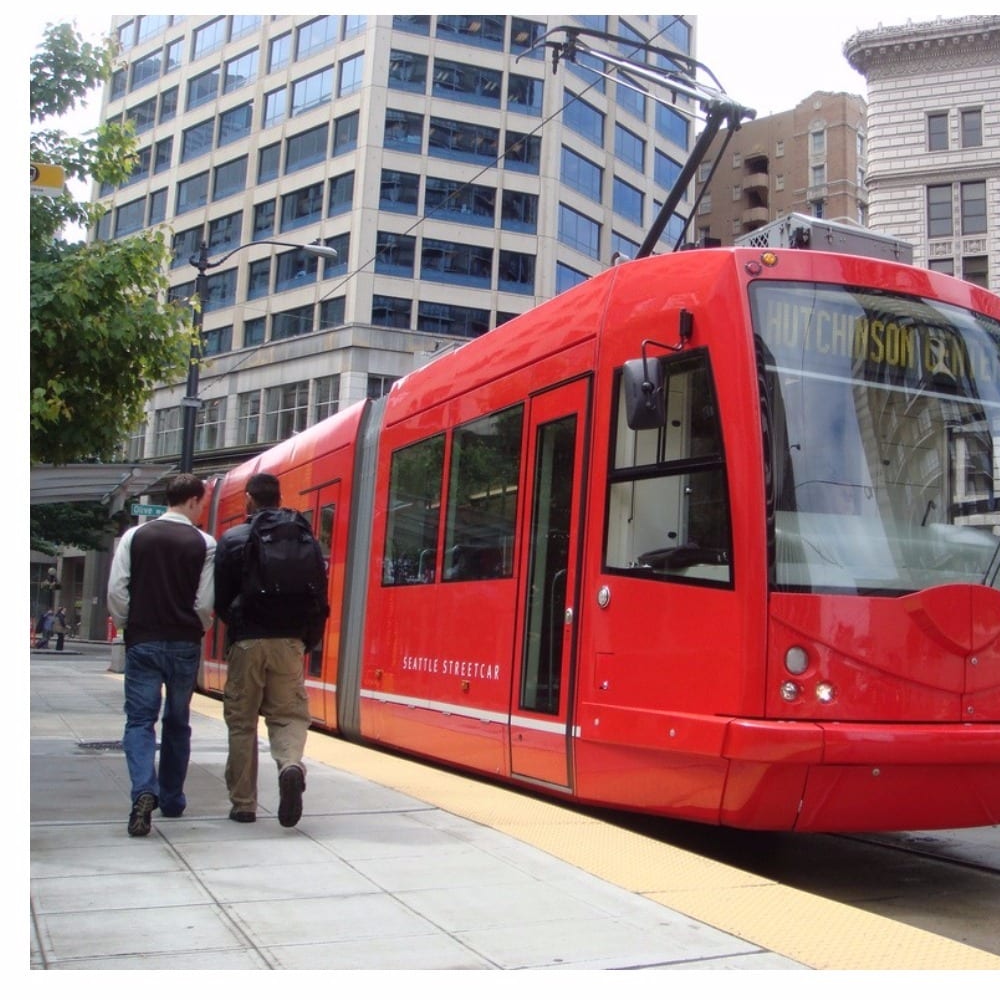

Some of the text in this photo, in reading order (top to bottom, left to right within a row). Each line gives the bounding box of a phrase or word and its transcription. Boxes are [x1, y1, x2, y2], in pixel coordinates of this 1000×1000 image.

[764, 299, 915, 370] HUTCHINSON
[402, 656, 500, 680] SEATTLE STREETCAR
